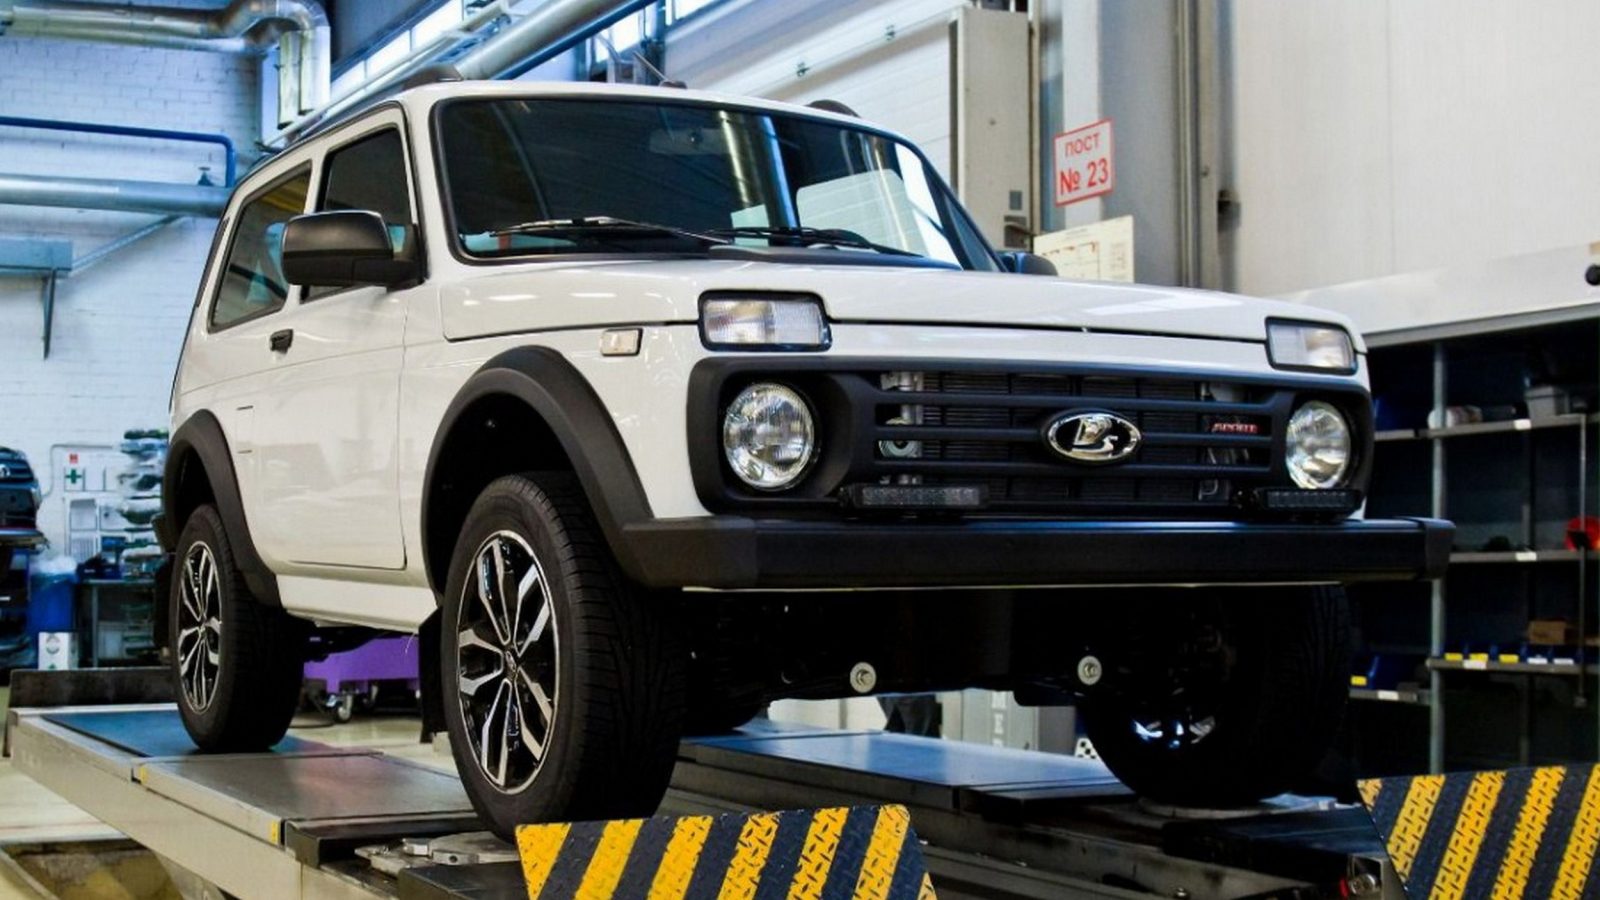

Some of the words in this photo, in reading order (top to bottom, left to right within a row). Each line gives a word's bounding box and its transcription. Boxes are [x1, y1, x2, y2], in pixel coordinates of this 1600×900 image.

[1065, 132, 1100, 157] ПОСТ
[1060, 169, 1081, 195] №
[1087, 158, 1109, 187] 23
